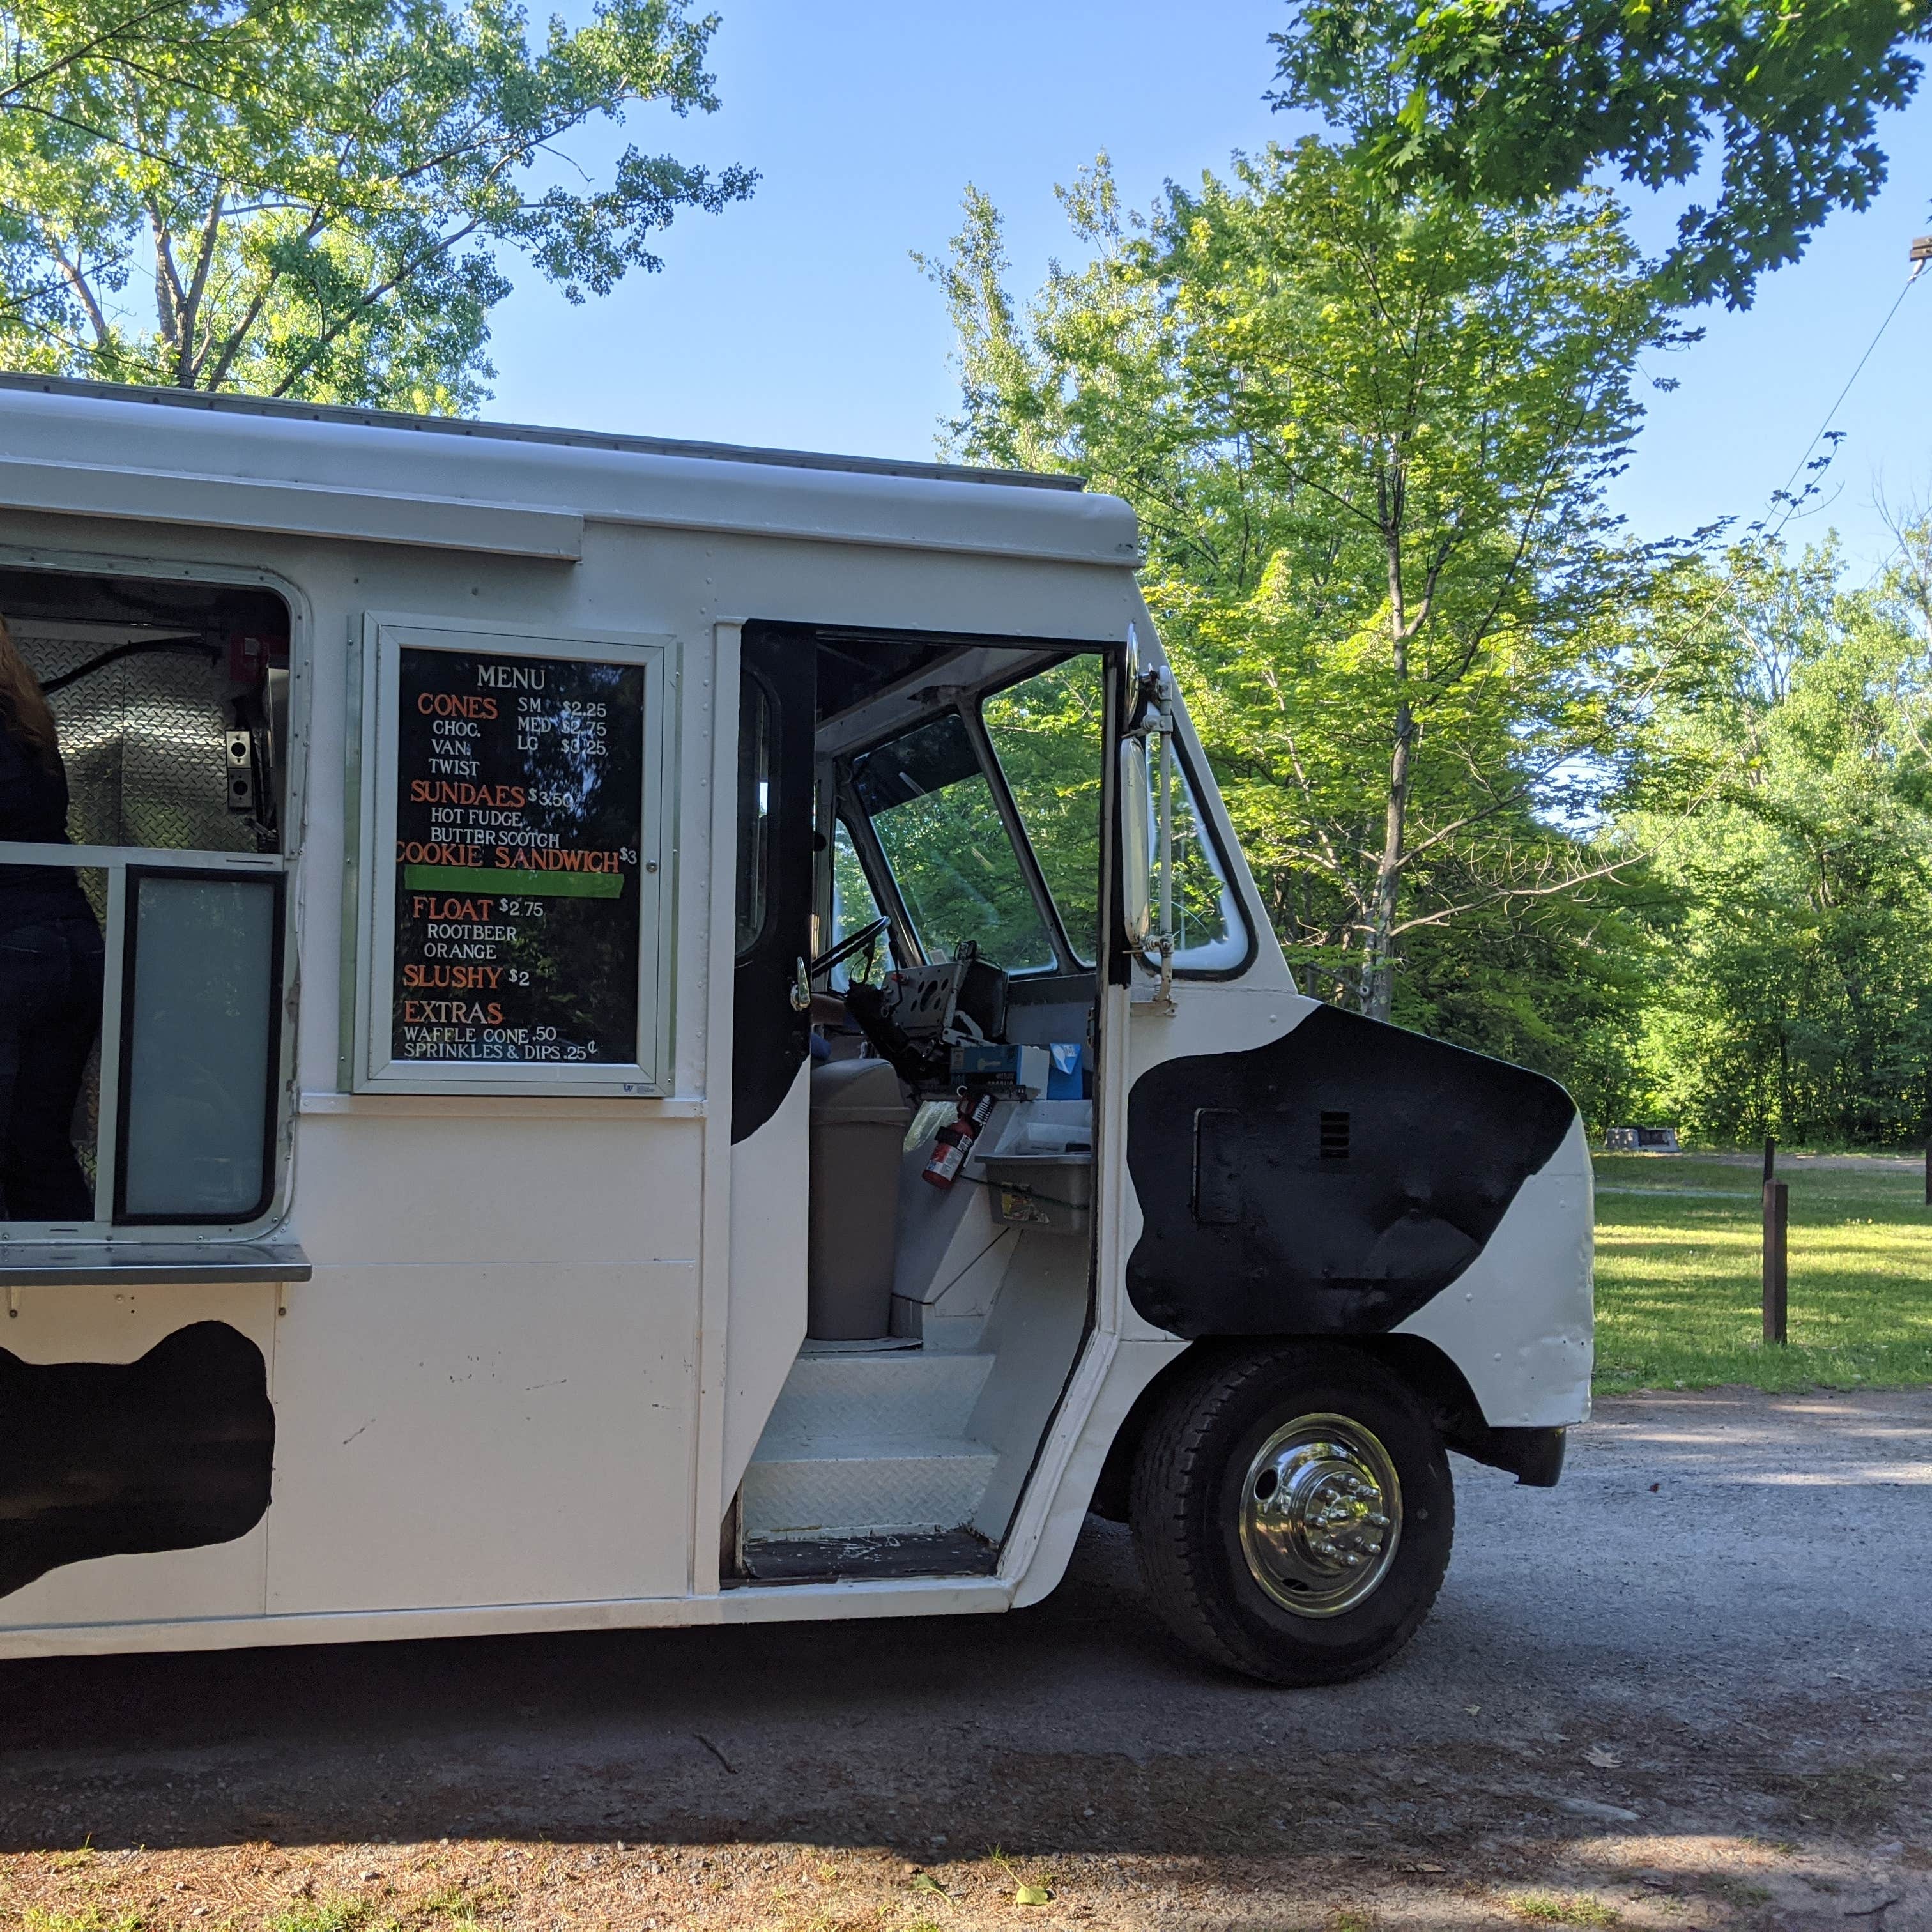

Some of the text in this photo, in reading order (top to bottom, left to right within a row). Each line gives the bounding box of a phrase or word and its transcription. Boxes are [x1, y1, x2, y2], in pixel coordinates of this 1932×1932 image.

[477, 665, 546, 690] MENU
[418, 693, 607, 719] CONES SM $2.25
[433, 716, 607, 737] CHOC. MED $2.75
[431, 739, 471, 756] VAN.
[518, 735, 539, 751] LG
[429, 758, 480, 776] TWIST
[411, 780, 574, 808] SUNDAES $3.50
[431, 808, 522, 827] HOT FUDGE
[495, 847, 619, 873] SANDWICH
[619, 847, 638, 864] $3
[413, 896, 493, 921] FLOAT
[424, 943, 497, 959] ORANGE
[403, 964, 530, 989] SLUSHY $2
[404, 1001, 503, 1025] EXTRAS
[404, 1026, 557, 1044] WAFFLE CONE .50
[404, 1043, 503, 1059] SPRINKLES
[507, 1046, 519, 1059] &
[524, 1046, 561, 1061] DIPS
